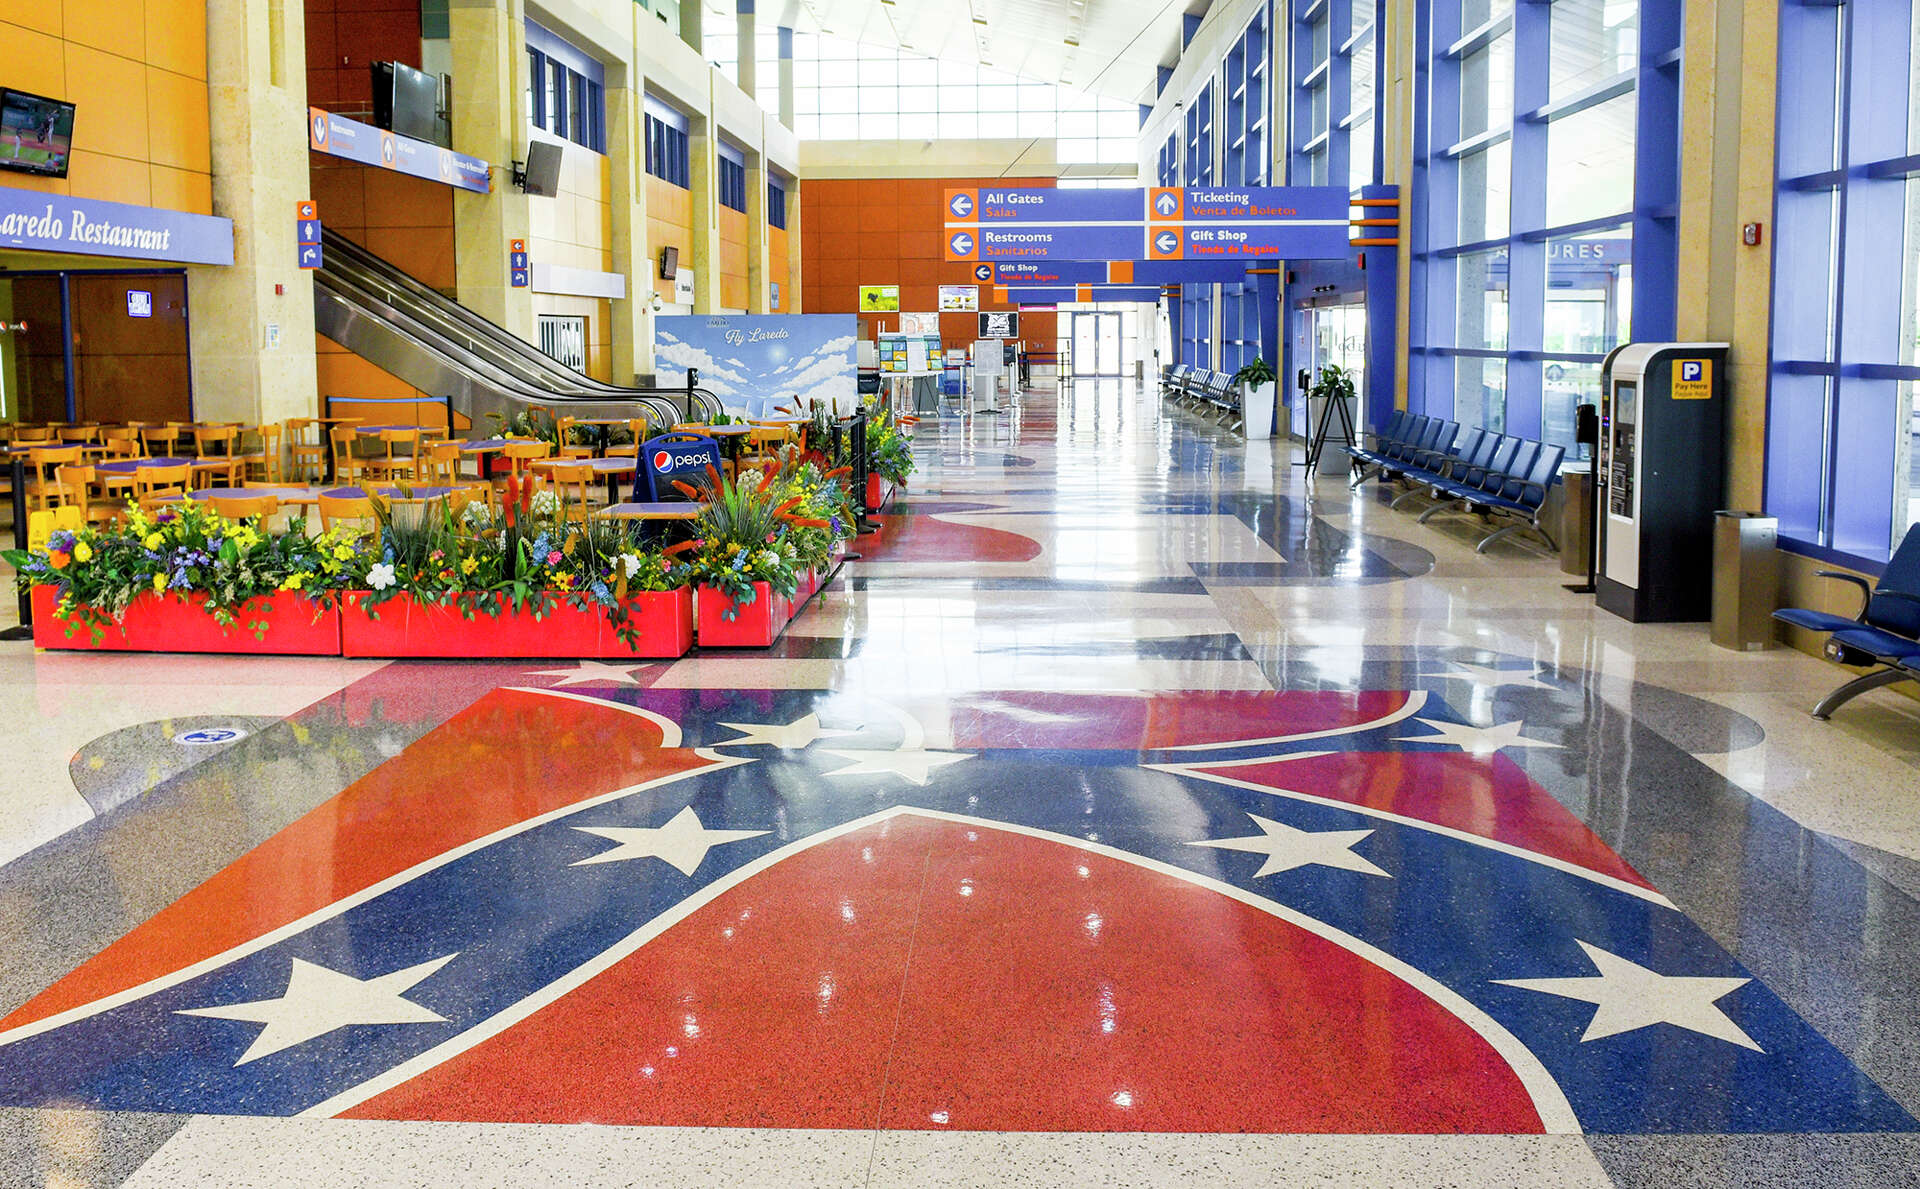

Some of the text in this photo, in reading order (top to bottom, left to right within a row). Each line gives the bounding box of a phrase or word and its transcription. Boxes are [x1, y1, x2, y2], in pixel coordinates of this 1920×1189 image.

[985, 193, 1044, 204] All Gates
[1190, 192, 1249, 205] Ticketing
[985, 207, 1017, 217] Salas
[1192, 206, 1297, 216] Venta de Boletos
[0, 204, 170, 250] aredo Restaurant
[985, 231, 1053, 243] Restrooms
[1190, 230, 1248, 243] Gift Shop
[986, 246, 1048, 256] Sanitarios
[1191, 244, 1225, 254] Tienda
[999, 264, 1039, 273] Gift Shop
[725, 327, 790, 347] Fly Laredo
[1684, 363, 1700, 380] P
[675, 451, 712, 469] pepsi
